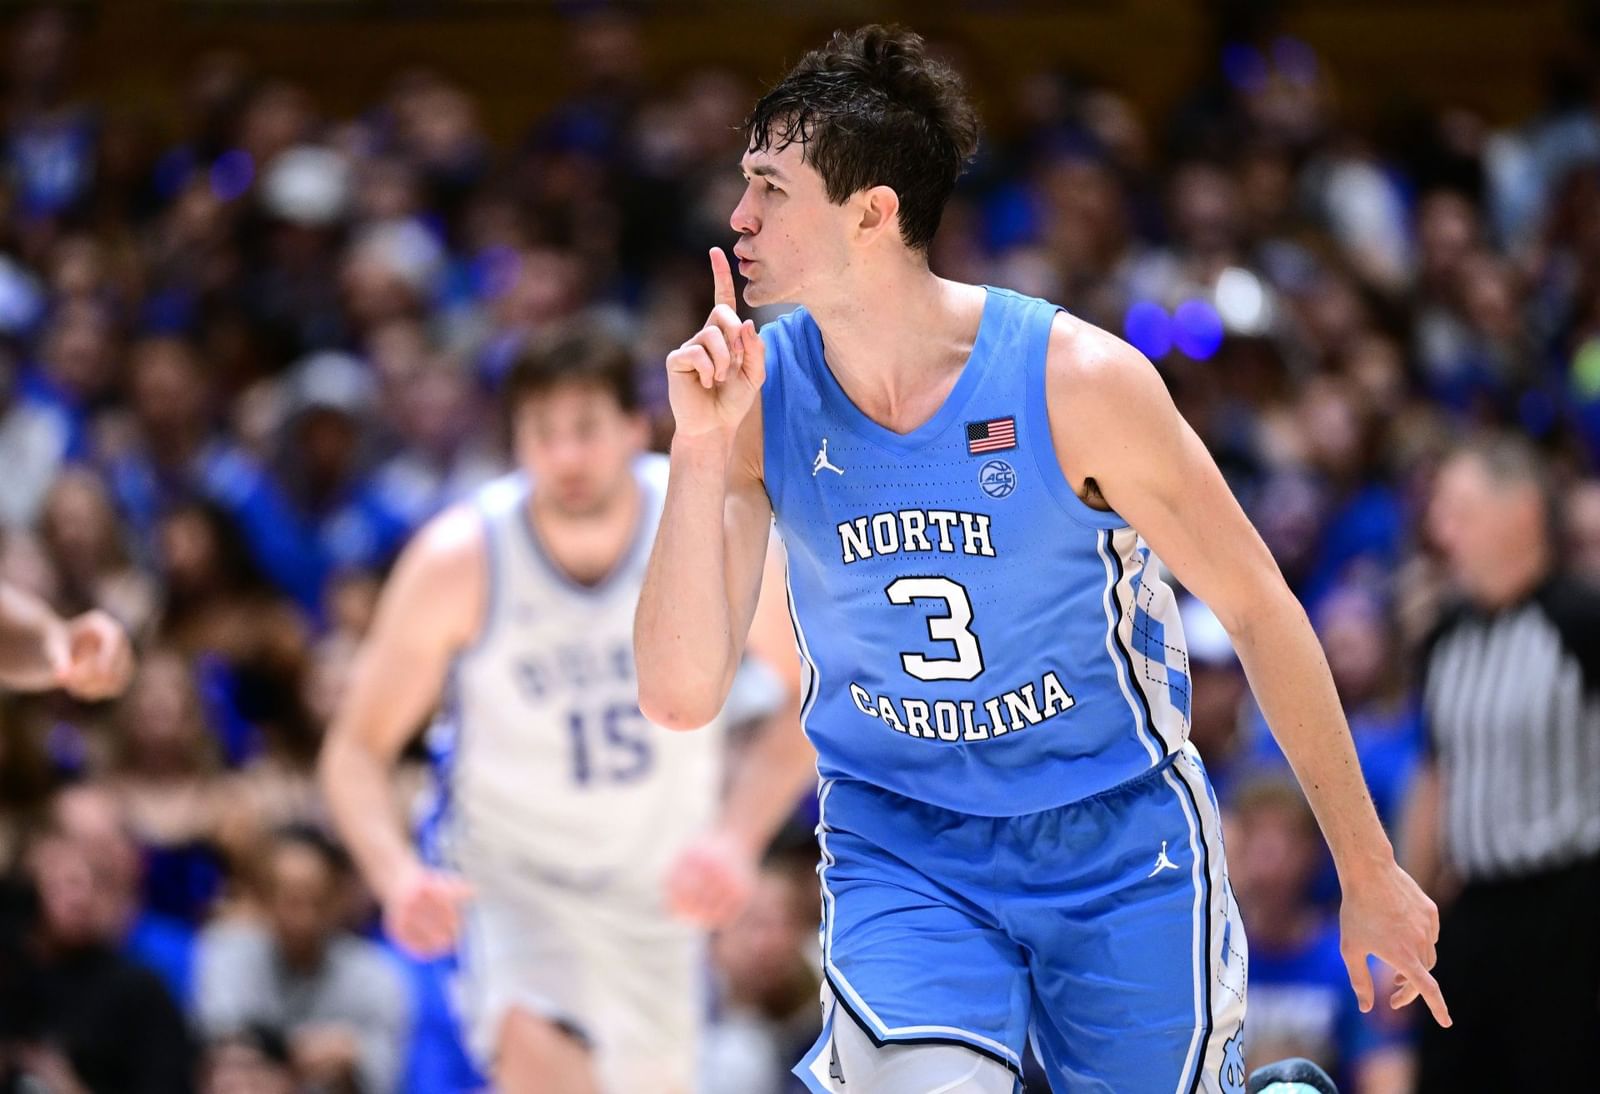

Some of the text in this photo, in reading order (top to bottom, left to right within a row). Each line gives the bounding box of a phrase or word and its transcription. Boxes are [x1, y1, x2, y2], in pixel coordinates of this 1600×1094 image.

[985, 472, 1012, 483] ACC
[838, 509, 997, 564] NORTH
[885, 576, 985, 682] 3
[850, 671, 1075, 742] CAROLINA
[567, 703, 656, 787] 15
